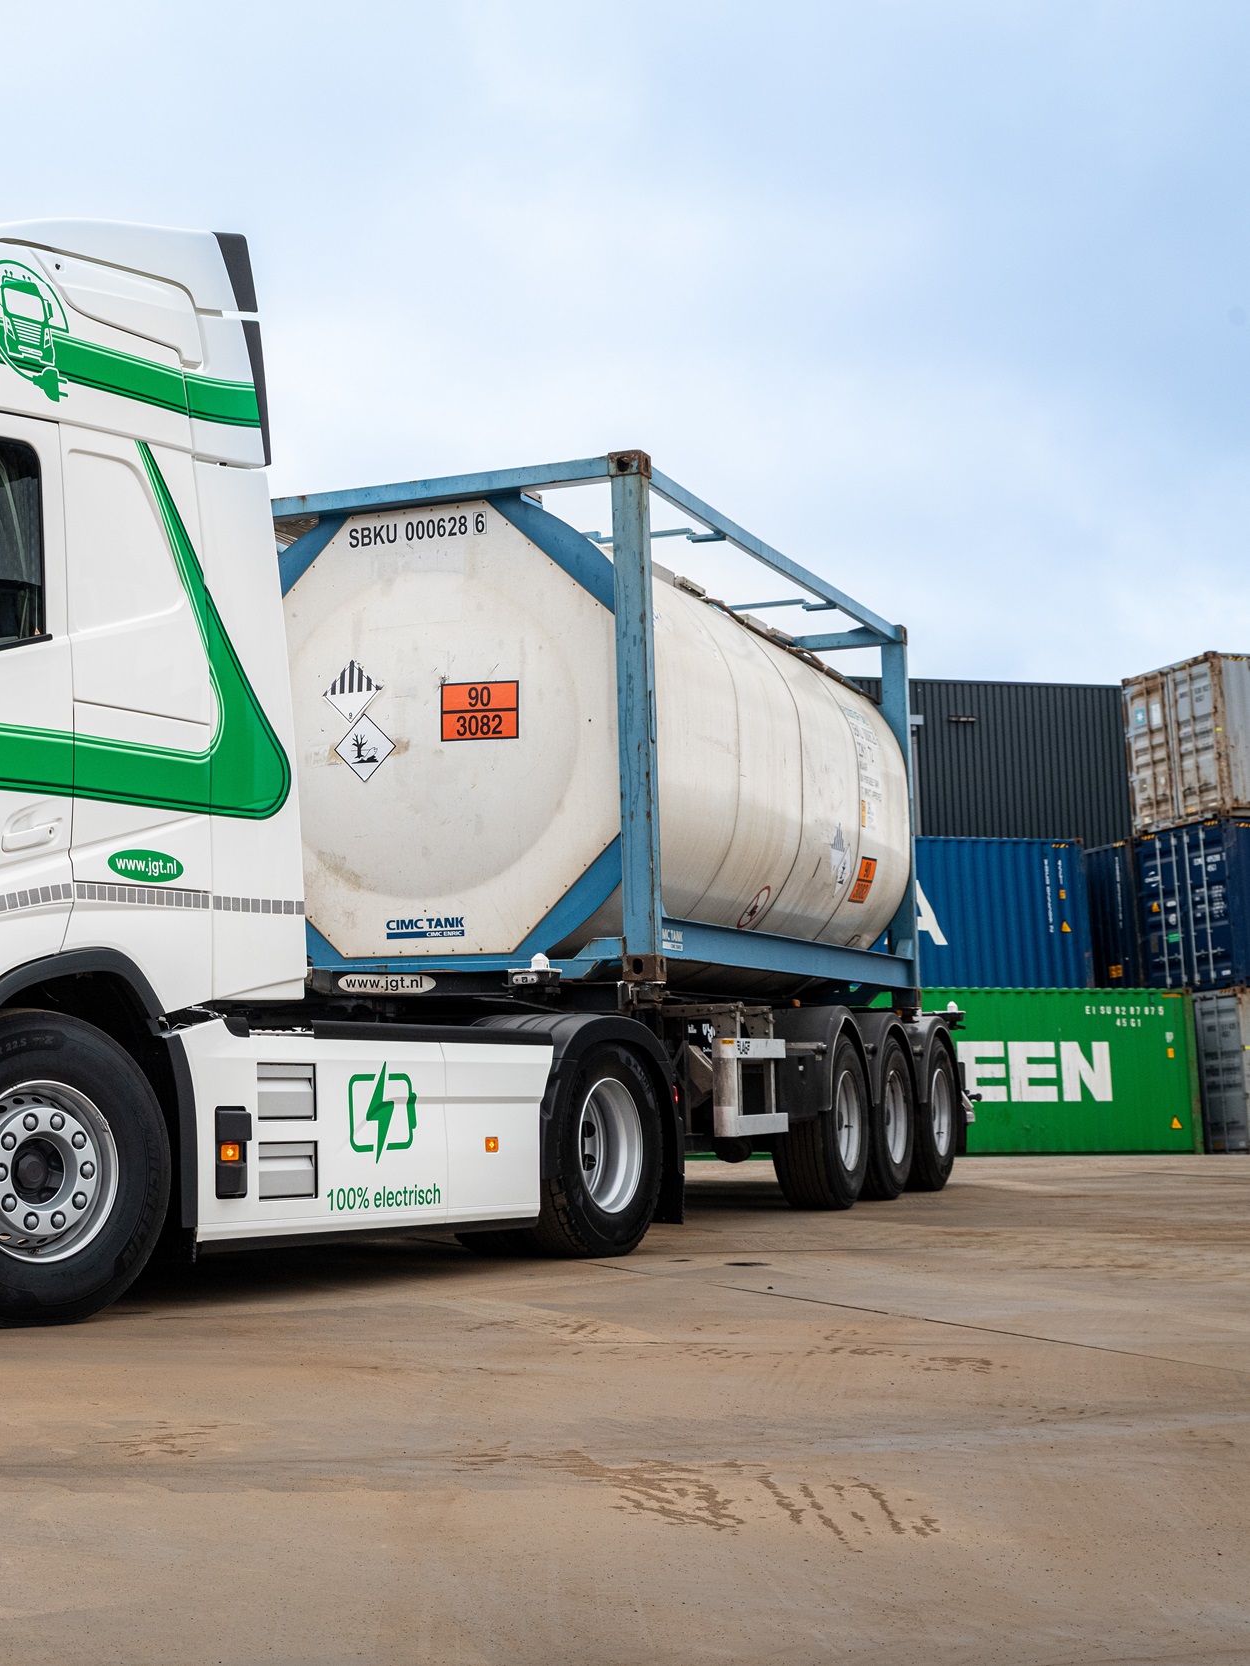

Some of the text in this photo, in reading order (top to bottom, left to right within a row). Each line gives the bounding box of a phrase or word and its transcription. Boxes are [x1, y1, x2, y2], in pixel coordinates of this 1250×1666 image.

[348, 512, 487, 548] SBKU 000628 6
[467, 686, 492, 708] 90
[456, 714, 503, 737] 3082
[115, 857, 177, 876] www.jgt.nl
[386, 917, 465, 931] CIMC TANK
[345, 976, 423, 992] www.jgt.nl
[957, 1041, 1113, 1102] EEN
[326, 1183, 441, 1211] 100% electrisch
